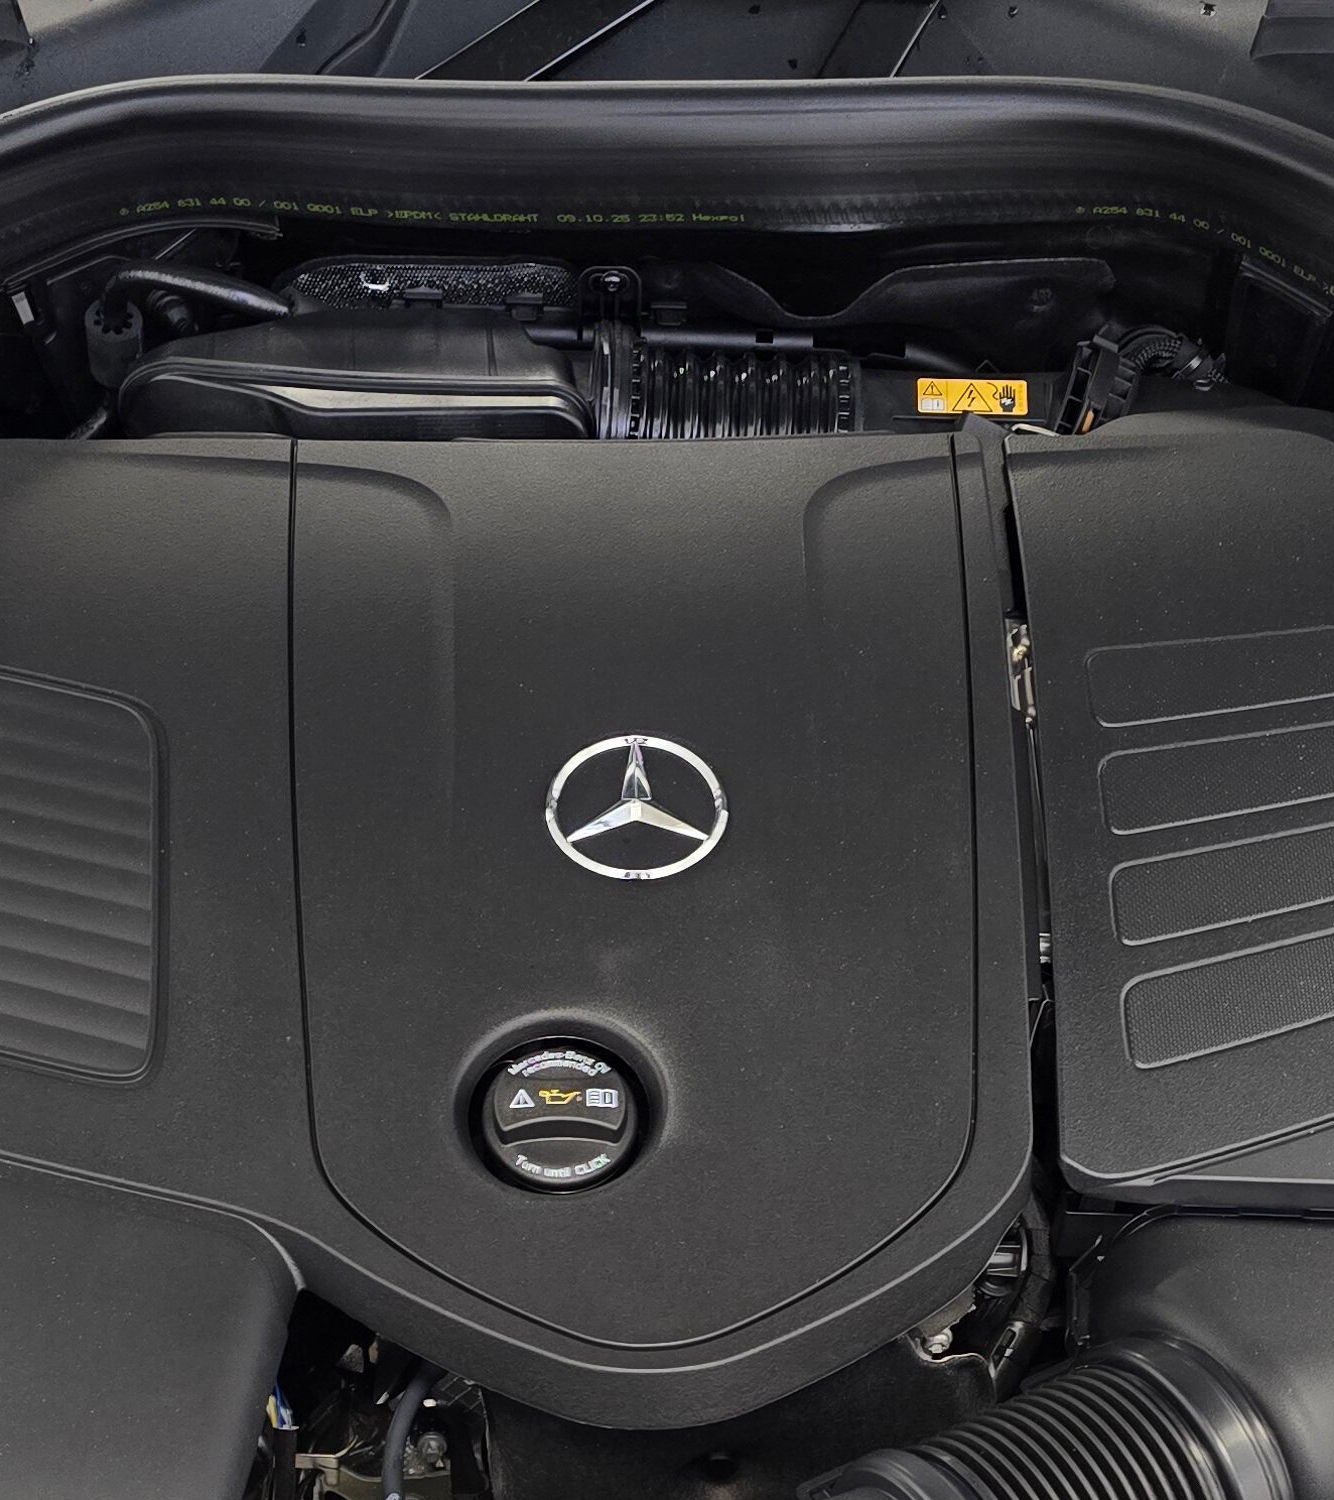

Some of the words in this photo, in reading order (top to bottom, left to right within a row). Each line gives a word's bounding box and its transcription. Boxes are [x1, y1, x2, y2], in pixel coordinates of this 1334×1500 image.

[209, 197, 226, 206] 44
[232, 197, 252, 207] 00
[273, 200, 299, 212] 001
[515, 1154, 542, 1174] Turn
[574, 1153, 612, 1174] CLICK
